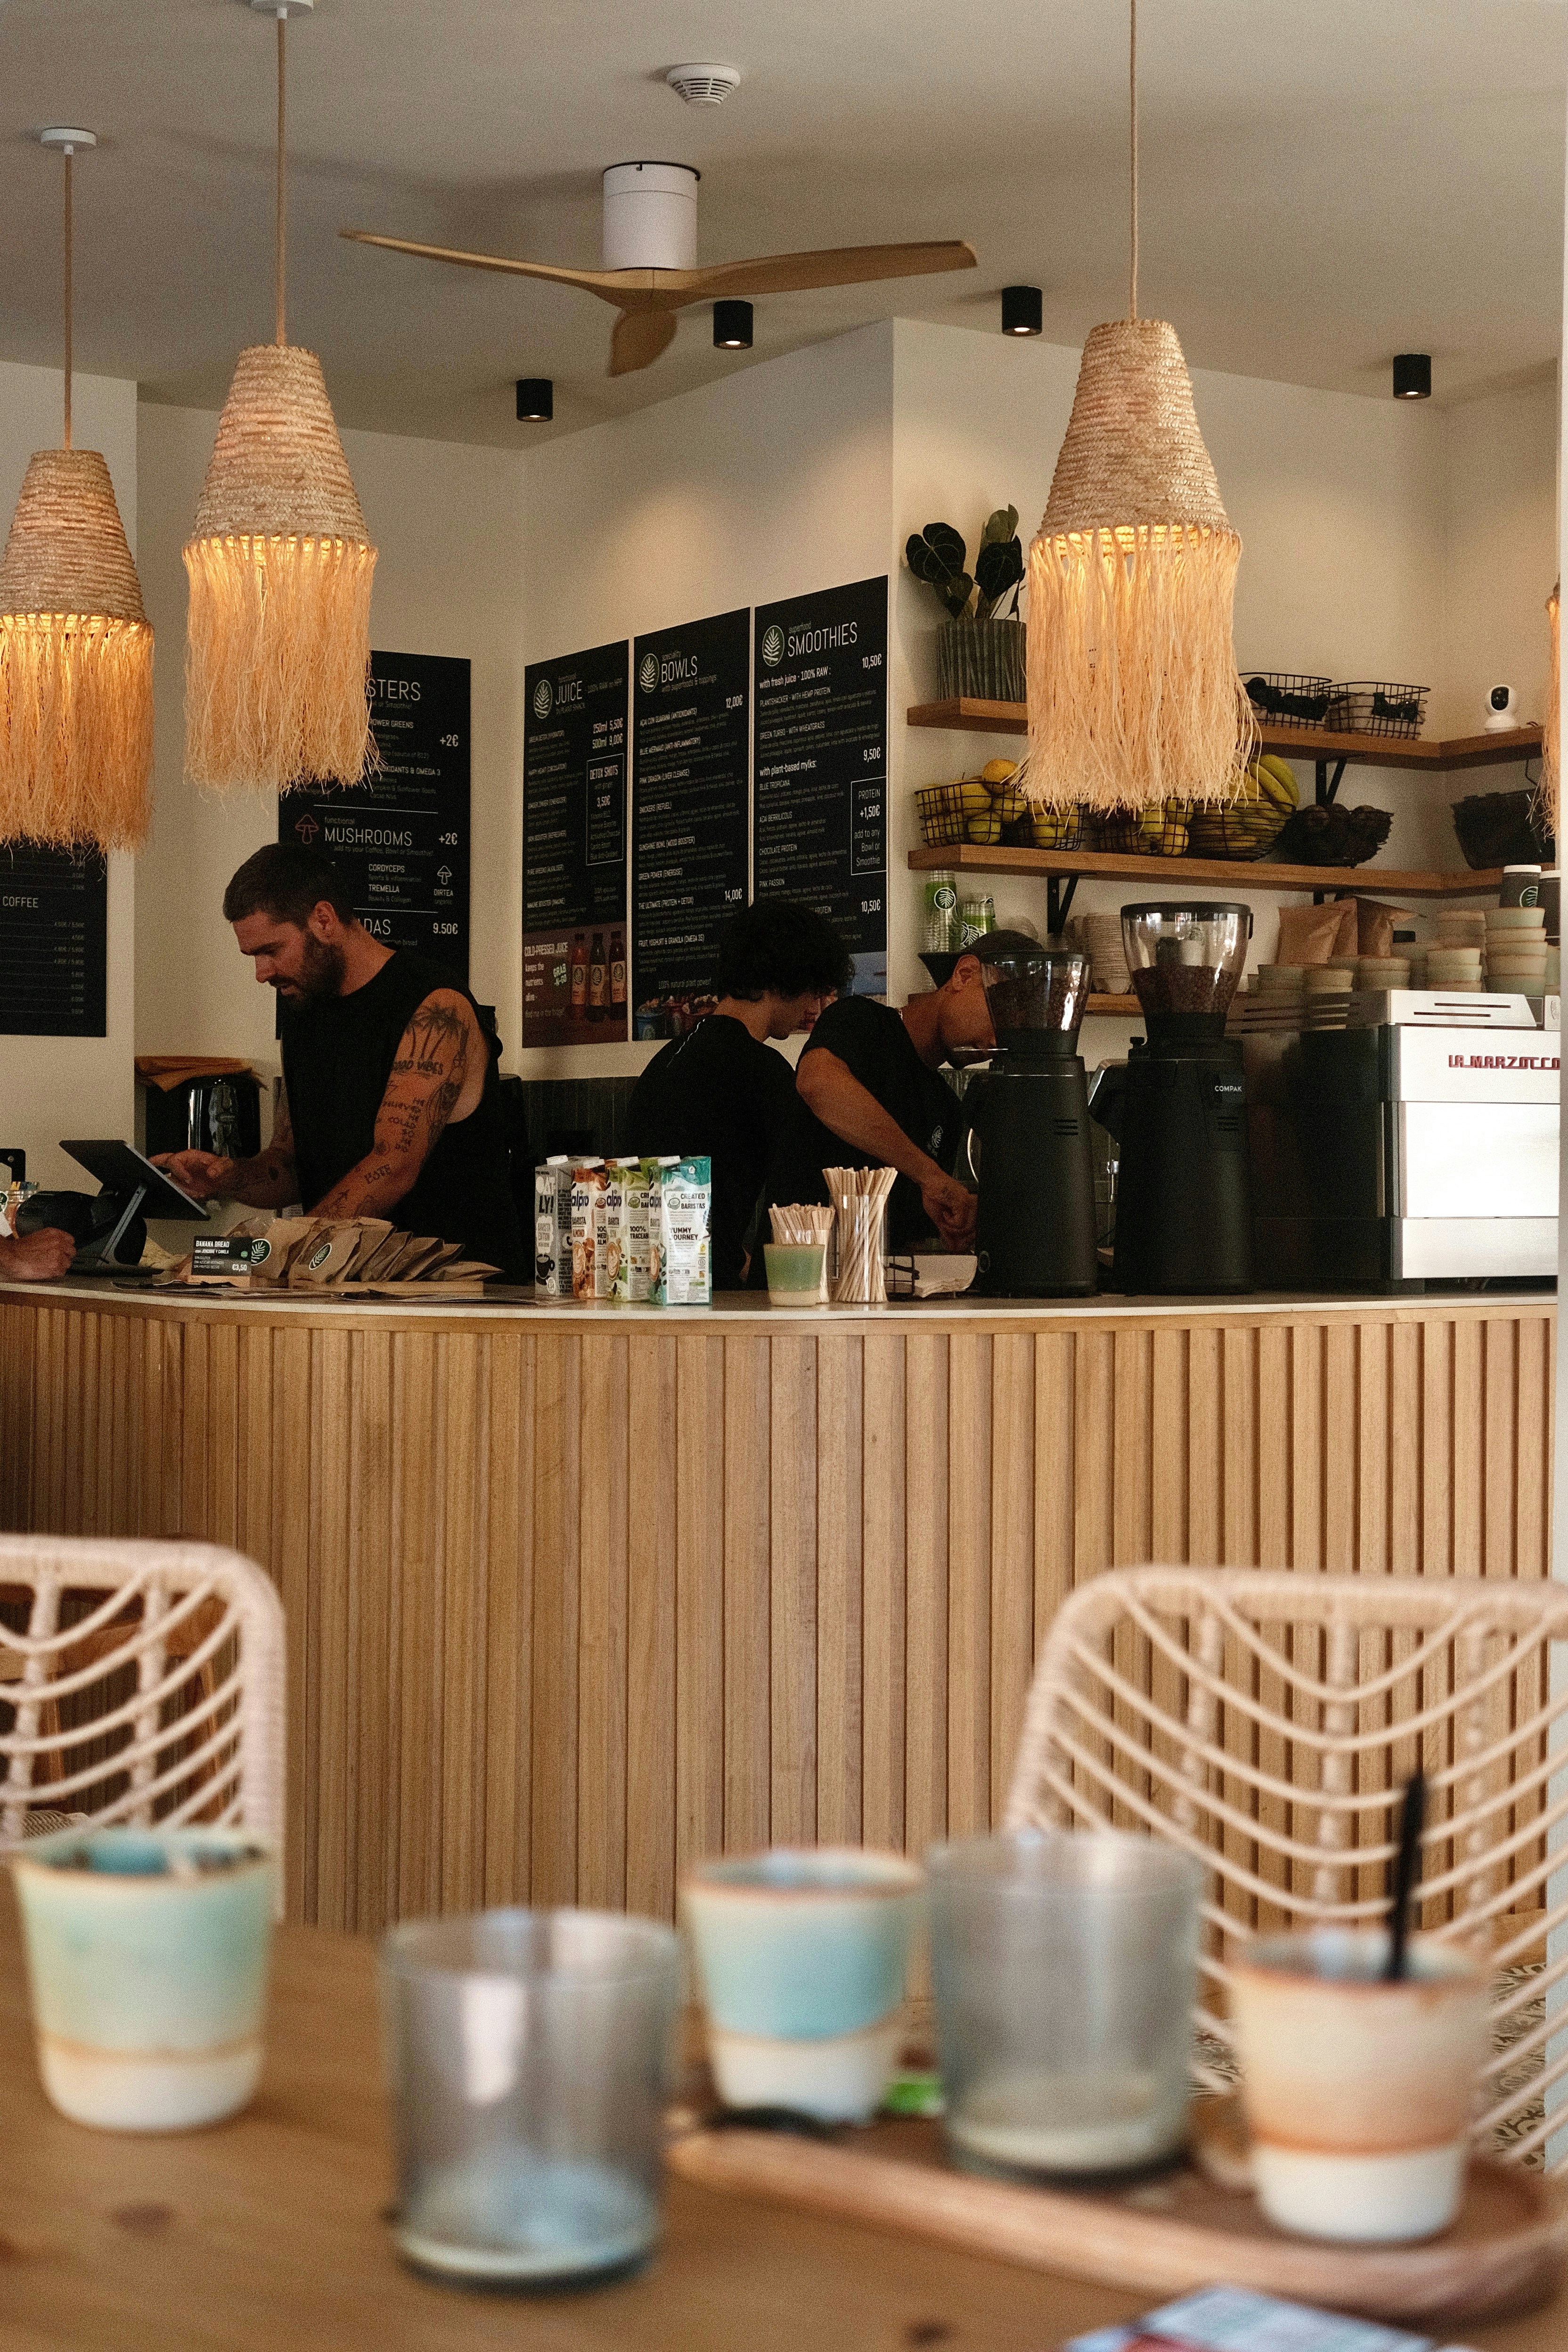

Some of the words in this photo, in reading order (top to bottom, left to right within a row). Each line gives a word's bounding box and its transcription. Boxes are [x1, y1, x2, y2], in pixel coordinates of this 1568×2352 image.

[788, 622, 858, 657] SMOOTHIES
[862, 653, 882, 670] 10,50€
[662, 656, 697, 683] BOWLS
[760, 679, 770, 689] with
[771, 676, 784, 686] fresh
[784, 674, 796, 686] juice
[801, 669, 816, 681] 100%
[817, 666, 828, 677] RAW
[366, 678, 421, 701] STERS
[555, 681, 582, 705] JUICE
[792, 691, 801, 701] WITH
[802, 689, 813, 699] HEMP
[814, 687, 831, 697] PROTEIN
[726, 695, 743, 709] 12,00€
[593, 720, 608, 734] 250ml
[609, 718, 624, 731] 5,50€
[760, 731, 773, 741] GREEN
[773, 728, 786, 738] TURBO
[789, 726, 799, 735] WITH
[440, 734, 458, 747] +2€
[592, 736, 607, 749] 500ml
[609, 733, 623, 747] 9,00€
[864, 747, 881, 763] 9,50€
[590, 768, 603, 780] DETOX
[604, 765, 619, 777] SHOTS
[760, 767, 770, 777] with
[771, 761, 800, 777] plant-based
[760, 782, 769, 791] BLUE
[596, 795, 611, 808] 3,50€
[858, 789, 880, 800] PROTEIN
[860, 804, 880, 820] +1,50€
[325, 827, 412, 846] MUSHROOMS
[439, 833, 458, 845] +2€
[855, 830, 864, 839] add
[871, 829, 880, 838] any
[759, 846, 780, 856] CHOCOLATE
[781, 843, 797, 853] PROTEIN
[861, 842, 874, 852] Bowl
[368, 864, 405, 873] CORDYCEPS
[856, 856, 880, 867] Smoothie
[368, 884, 400, 893] TREMELLA
[759, 880, 768, 889] PINK
[768, 878, 785, 887] PASSION
[2, 896, 39, 908] COFFEE
[725, 888, 742, 902] 14,00€
[861, 899, 881, 914] 10,50€
[433, 923, 458, 935] 9.50€
[524, 943, 555, 956] COLD-PRESSED
[555, 942, 568, 954] JUICE
[554, 963, 566, 978] GRAB
[1448, 1054, 1465, 1068] LA
[1470, 1055, 1560, 1070] MARZOCCO
[539, 1195, 554, 1214] LY!
[571, 1190, 589, 1211] alpro
[606, 1189, 621, 1211] alpro
[232, 1264, 247, 1272] €3,50
